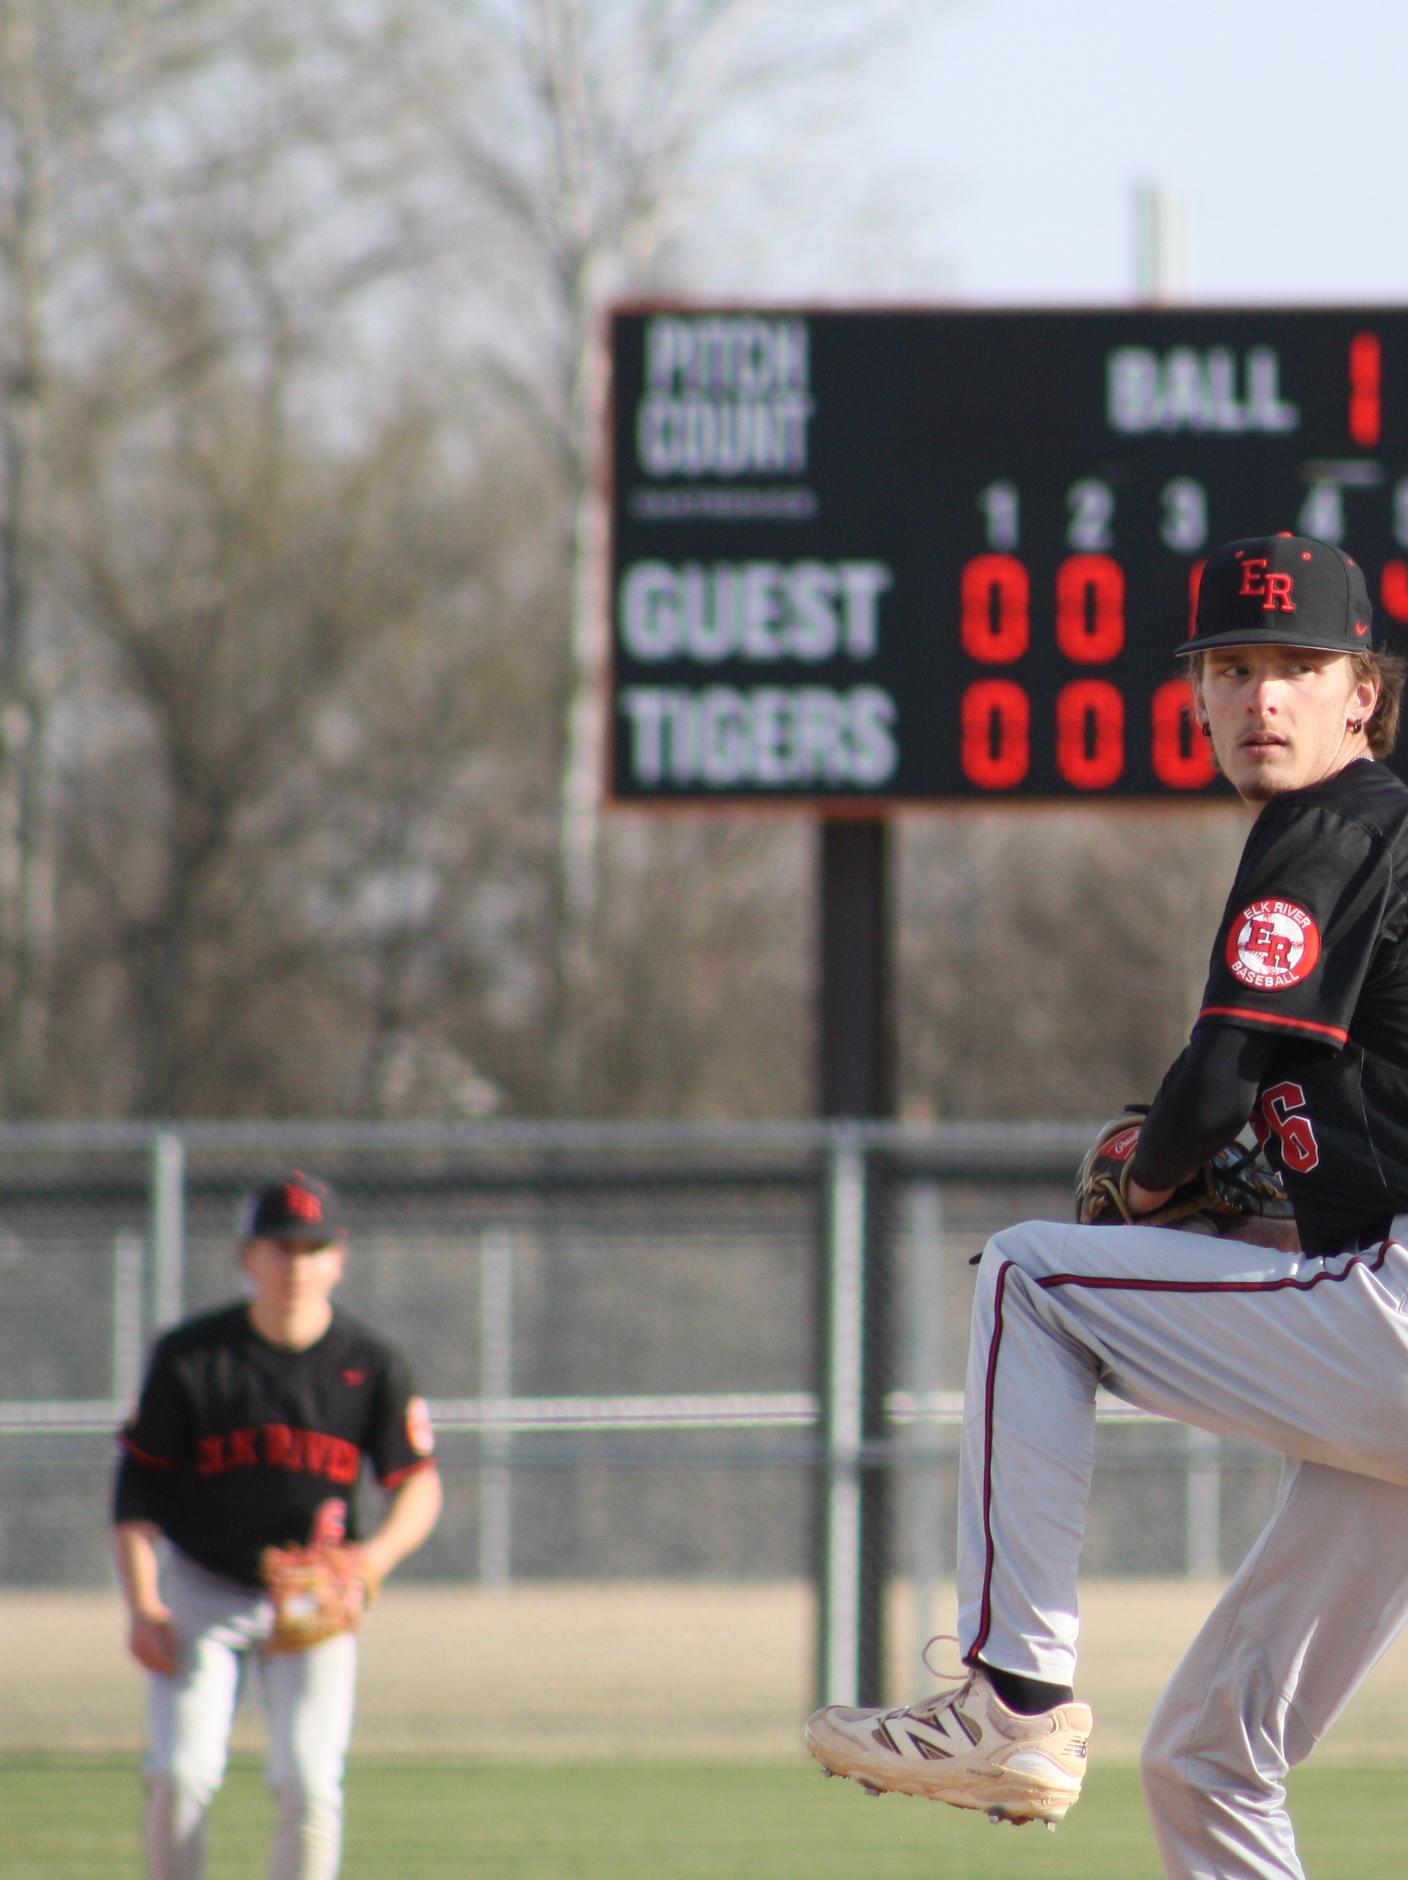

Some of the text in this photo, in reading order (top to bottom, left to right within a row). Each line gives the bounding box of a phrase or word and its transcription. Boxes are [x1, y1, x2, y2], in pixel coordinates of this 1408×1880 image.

[645, 317, 809, 393] PITCH
[1106, 345, 1297, 433] BALL
[637, 396, 813, 476] COUNT
[981, 483, 1019, 549] 1
[1067, 480, 1113, 552] 2
[1161, 479, 1208, 552] 3
[1302, 480, 1342, 543] 4
[620, 560, 892, 661] GUEST
[960, 554, 1031, 665] 0
[1055, 554, 1126, 664] 0
[1238, 559, 1297, 613] ER
[622, 685, 899, 786] TIGERS
[961, 679, 1031, 789] 0
[1056, 678, 1126, 789] 0
[1243, 902, 1311, 928] ELK RIVER
[1231, 960, 1299, 987] BASEBALL
